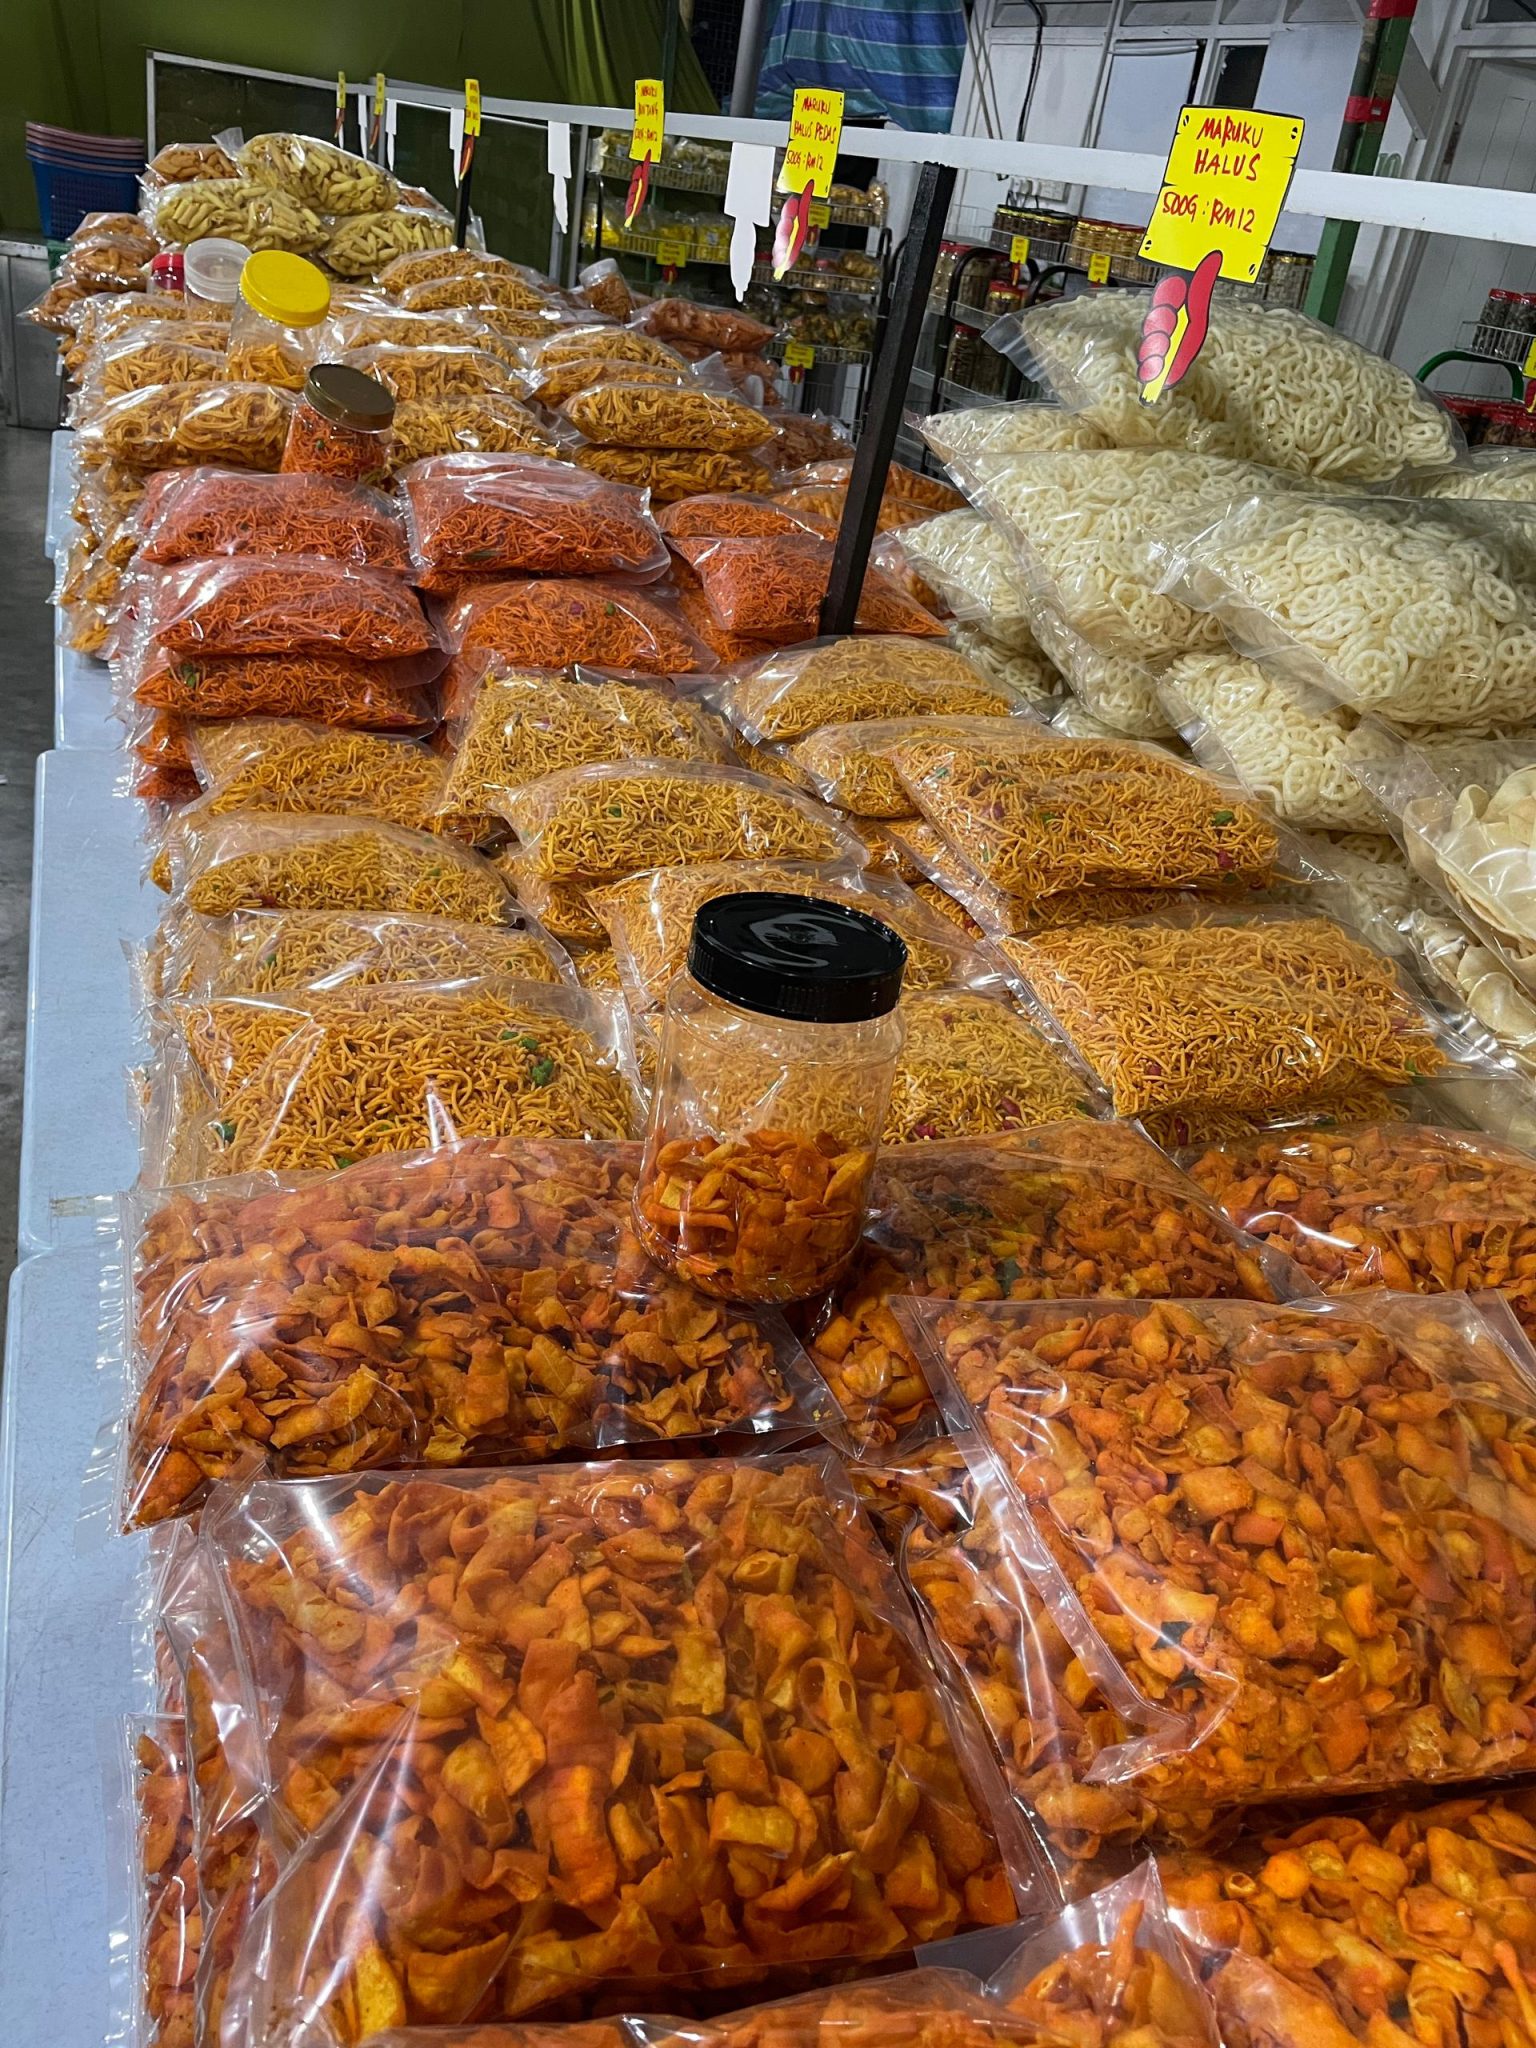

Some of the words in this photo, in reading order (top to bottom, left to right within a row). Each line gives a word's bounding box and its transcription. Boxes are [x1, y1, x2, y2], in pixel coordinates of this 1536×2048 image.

[794, 120, 813, 138] HALUS
[814, 122, 837, 144] PEDAS
[1196, 115, 1264, 148] MARUKU
[1194, 149, 1260, 181] HALUS
